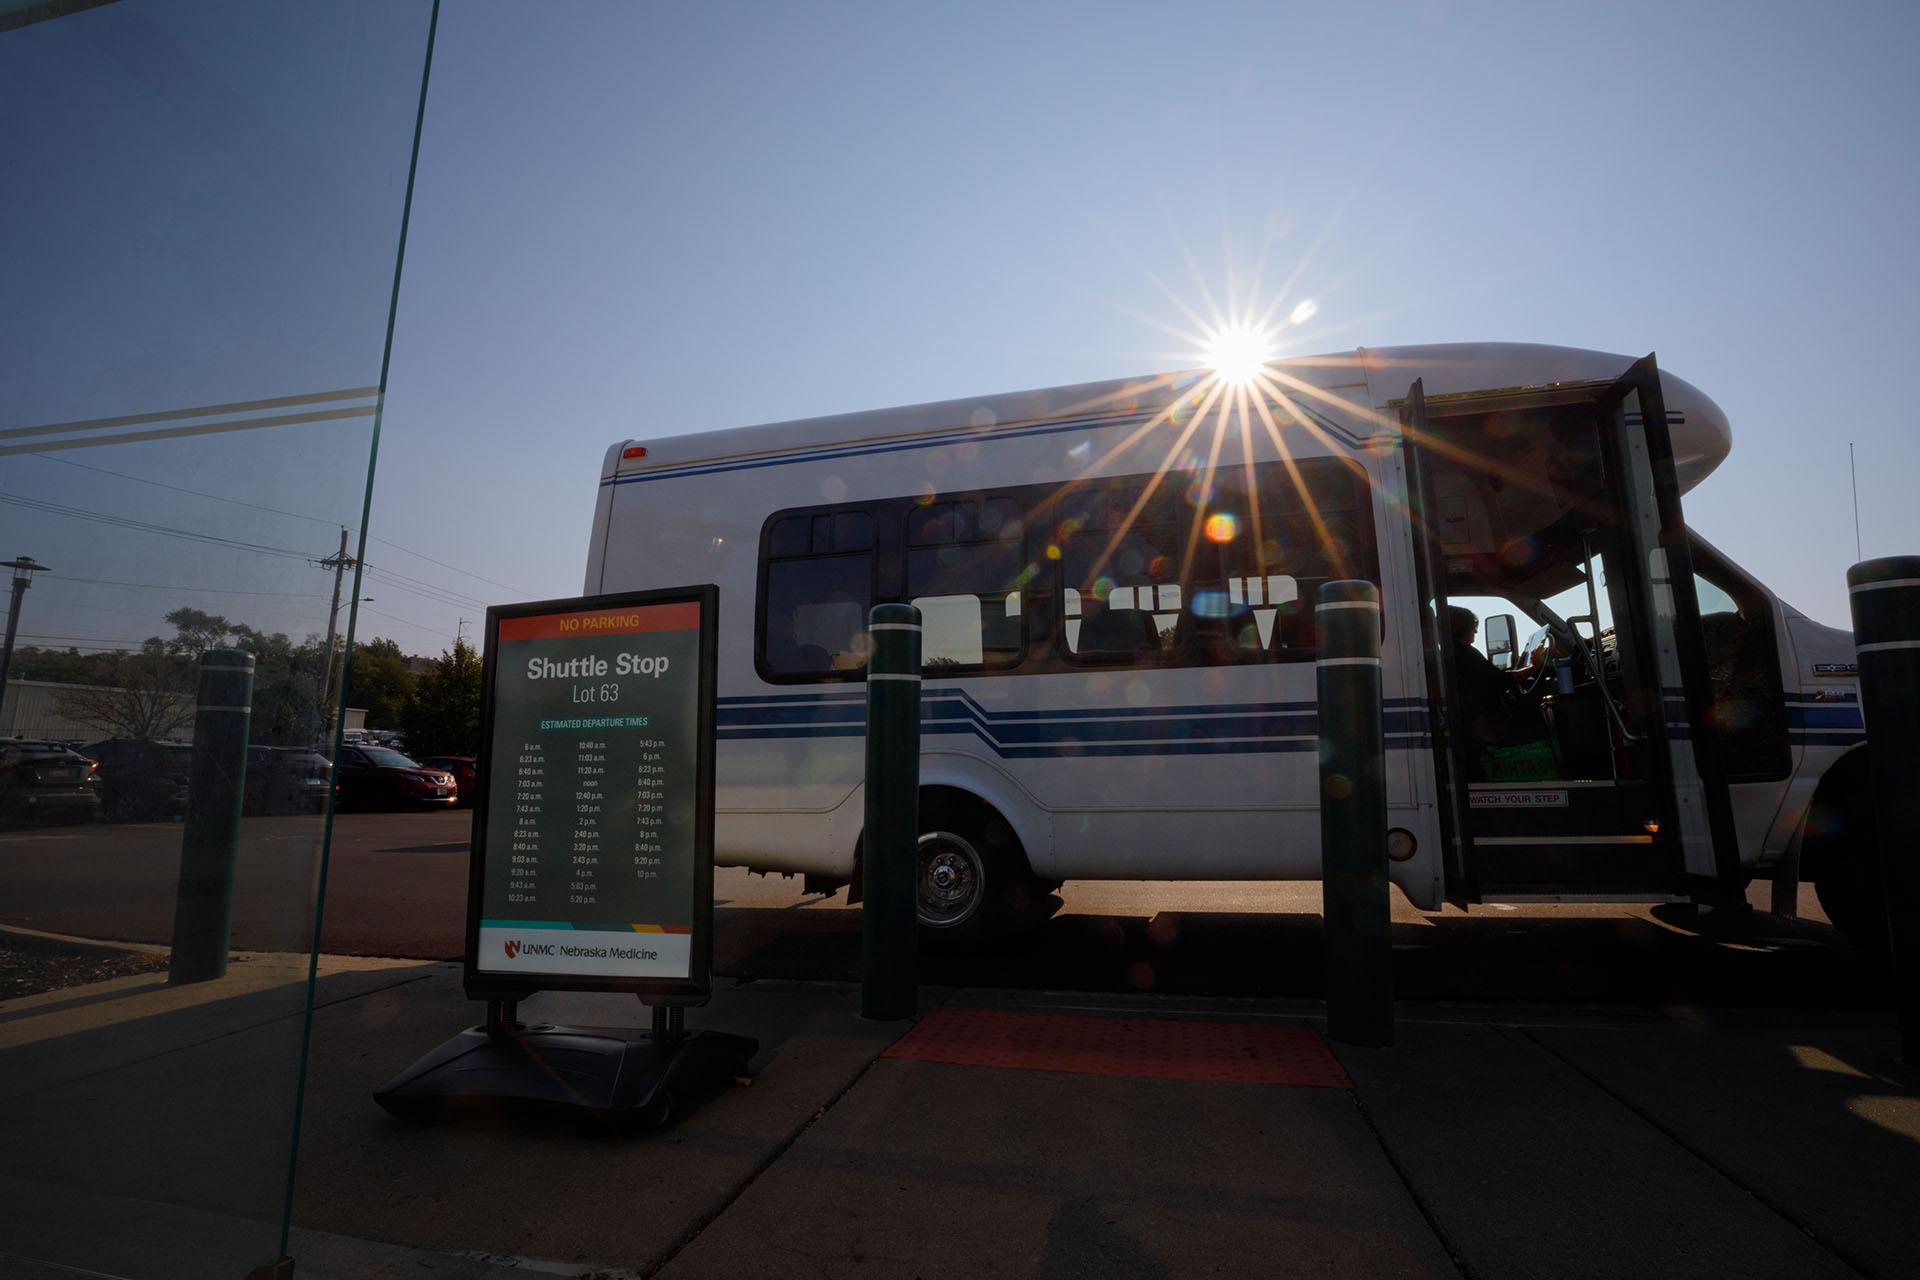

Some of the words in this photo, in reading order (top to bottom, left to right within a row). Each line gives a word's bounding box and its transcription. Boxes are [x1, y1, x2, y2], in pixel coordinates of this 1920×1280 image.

[559, 619, 579, 631] NO
[582, 614, 639, 629] PARKING
[527, 654, 608, 680] Shuttle
[616, 653, 669, 679] Stop
[573, 685, 595, 703] Lot
[600, 684, 618, 701] 63
[541, 719, 581, 729] ESTIMATED
[583, 717, 624, 727] DEPARTURE
[625, 717, 648, 726] TIMES
[652, 766, 664, 774] p.m.
[1505, 795, 1530, 803] YOUR
[1535, 795, 1559, 803] STEP
[650, 818, 663, 826] p.m.
[645, 831, 658, 839] p.m.
[649, 844, 662, 852] p.m.
[522, 943, 555, 956] UNMC
[560, 944, 607, 958] Nebraska
[609, 948, 657, 960] Medicine
